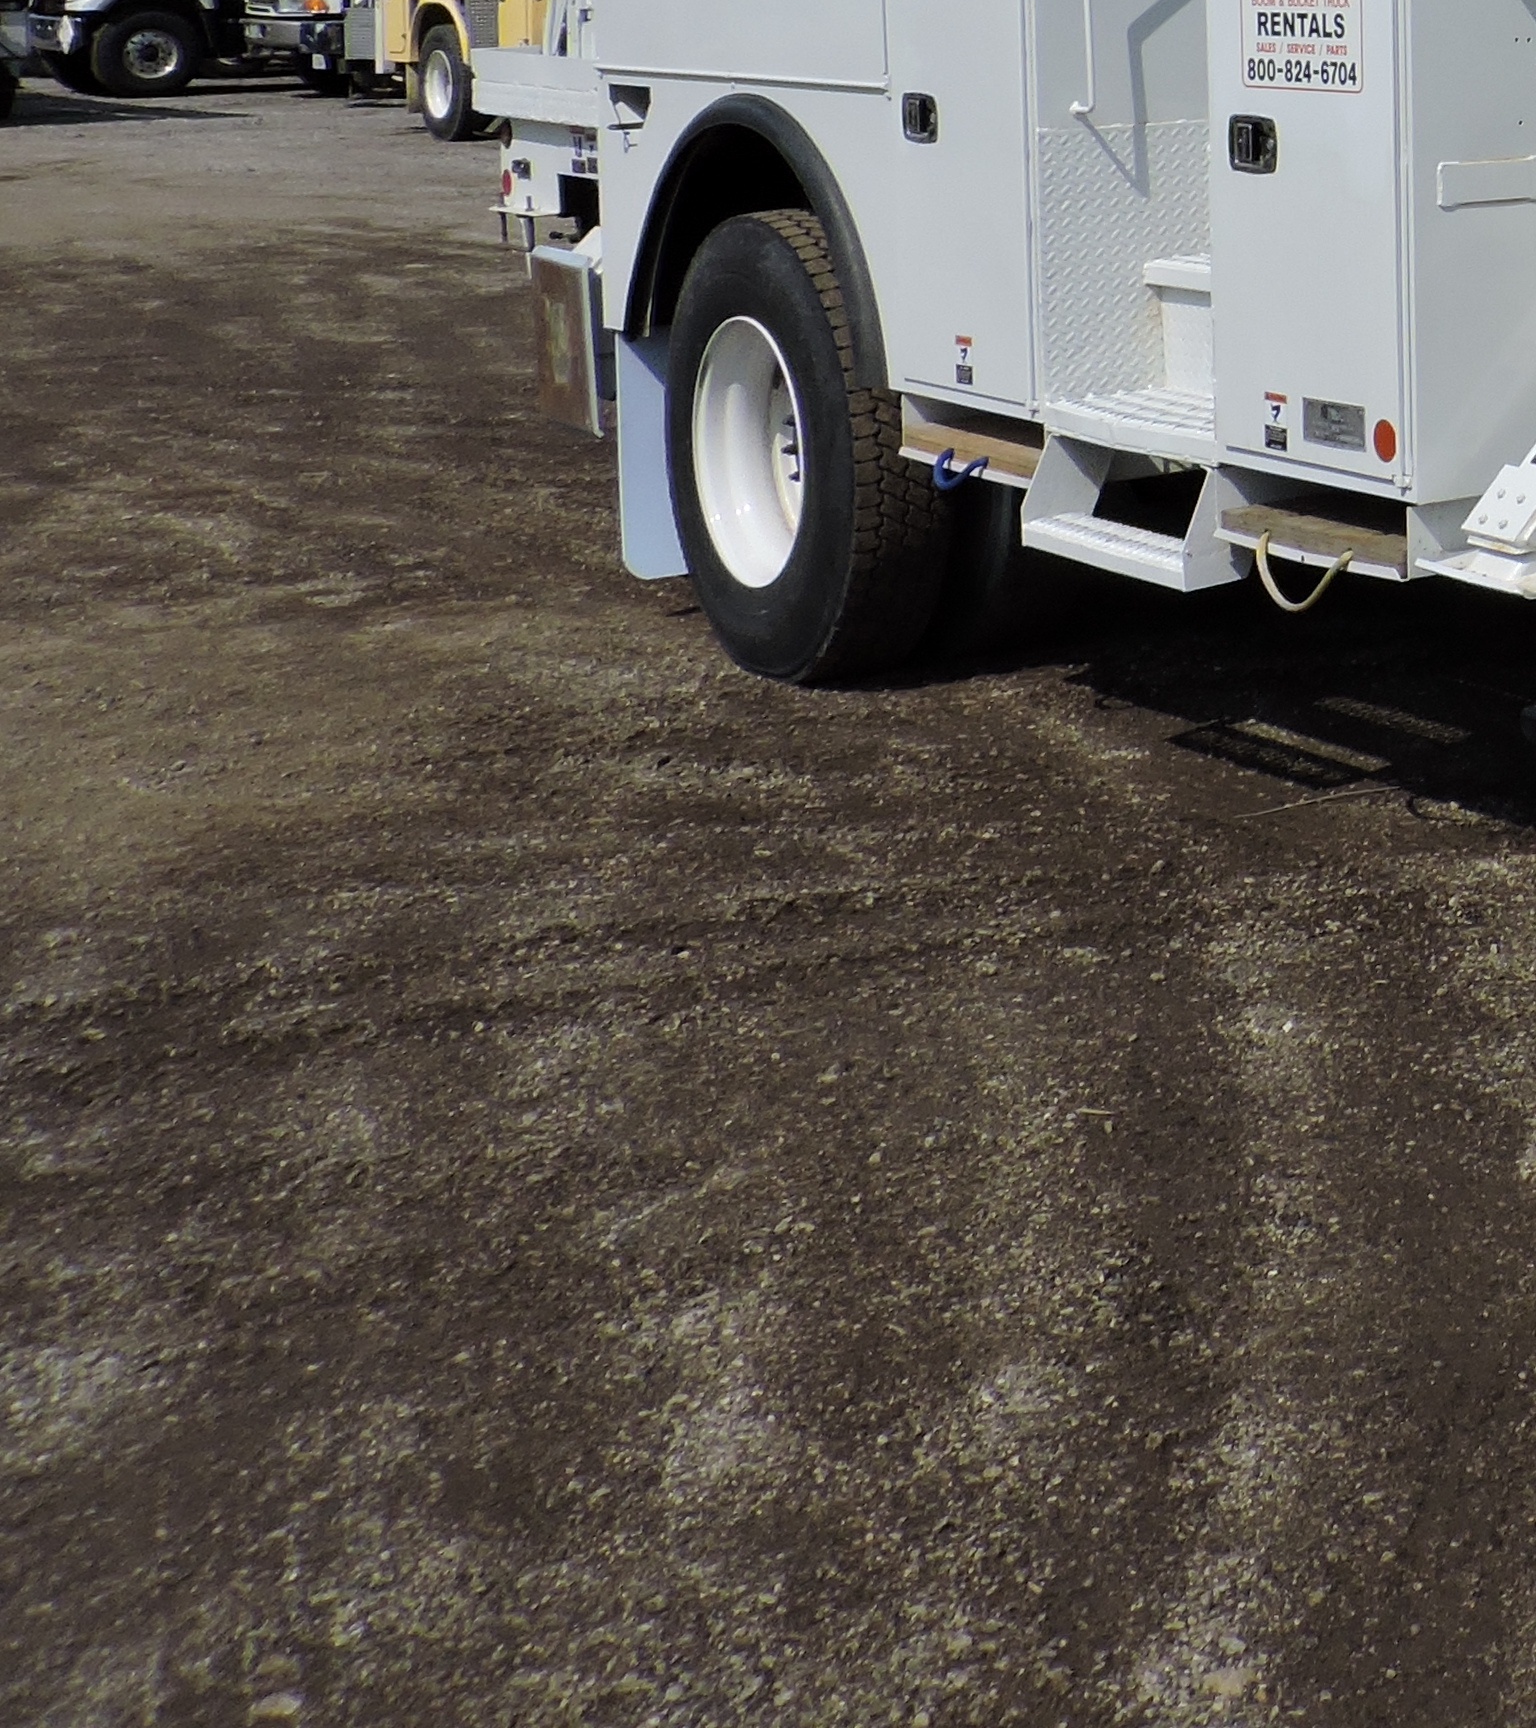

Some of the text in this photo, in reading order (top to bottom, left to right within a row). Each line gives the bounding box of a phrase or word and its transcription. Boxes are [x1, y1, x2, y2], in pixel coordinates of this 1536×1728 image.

[1257, 12, 1345, 39] RENTALS
[1256, 42, 1276, 53] SALES
[1287, 43, 1316, 55] SERVICE
[1326, 45, 1347, 56] PARTS
[1248, 58, 1356, 86] 800-824-6704
